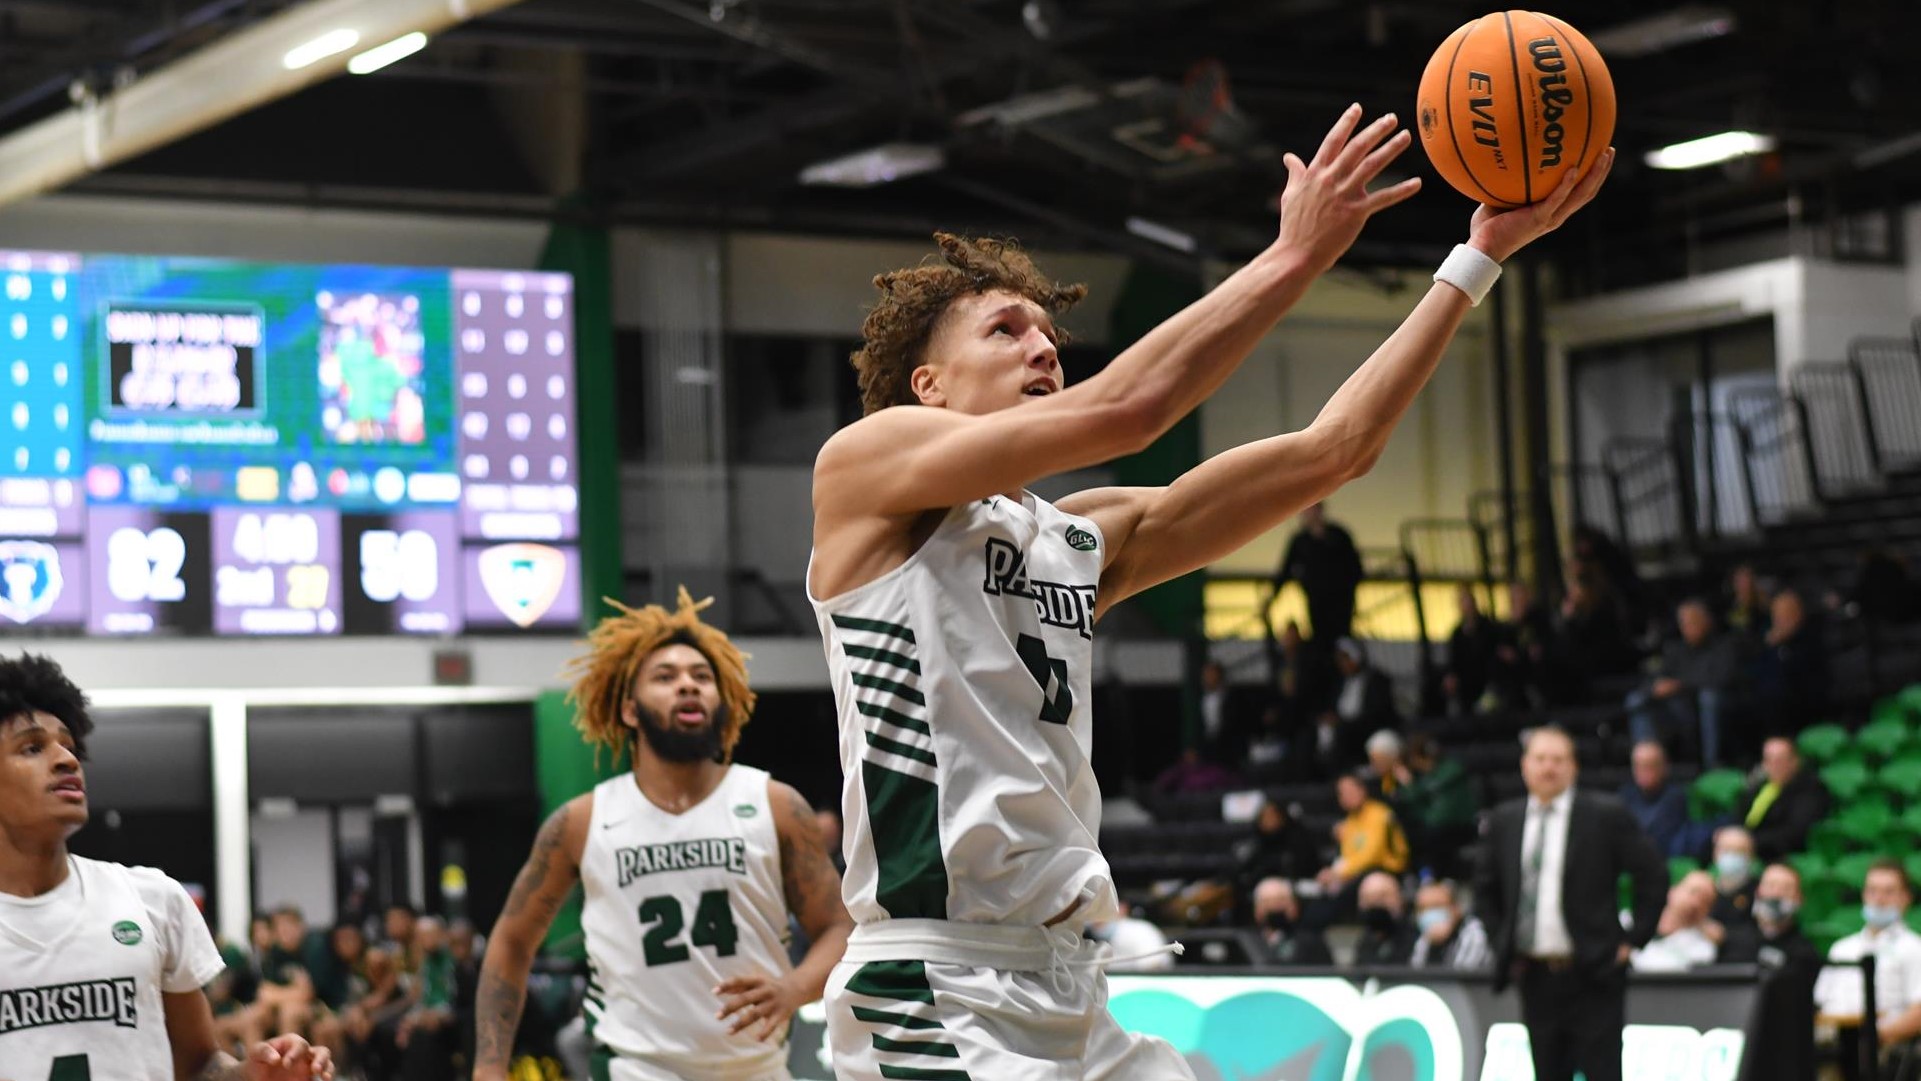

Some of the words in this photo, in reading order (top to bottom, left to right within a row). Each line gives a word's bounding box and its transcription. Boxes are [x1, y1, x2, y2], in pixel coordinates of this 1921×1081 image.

[1528, 36, 1573, 168] Wilson
[1493, 150, 1507, 171] NXT
[615, 837, 746, 888] PARKSIDE
[638, 889, 739, 967] 24
[0, 976, 137, 1034] ARKSIDE
